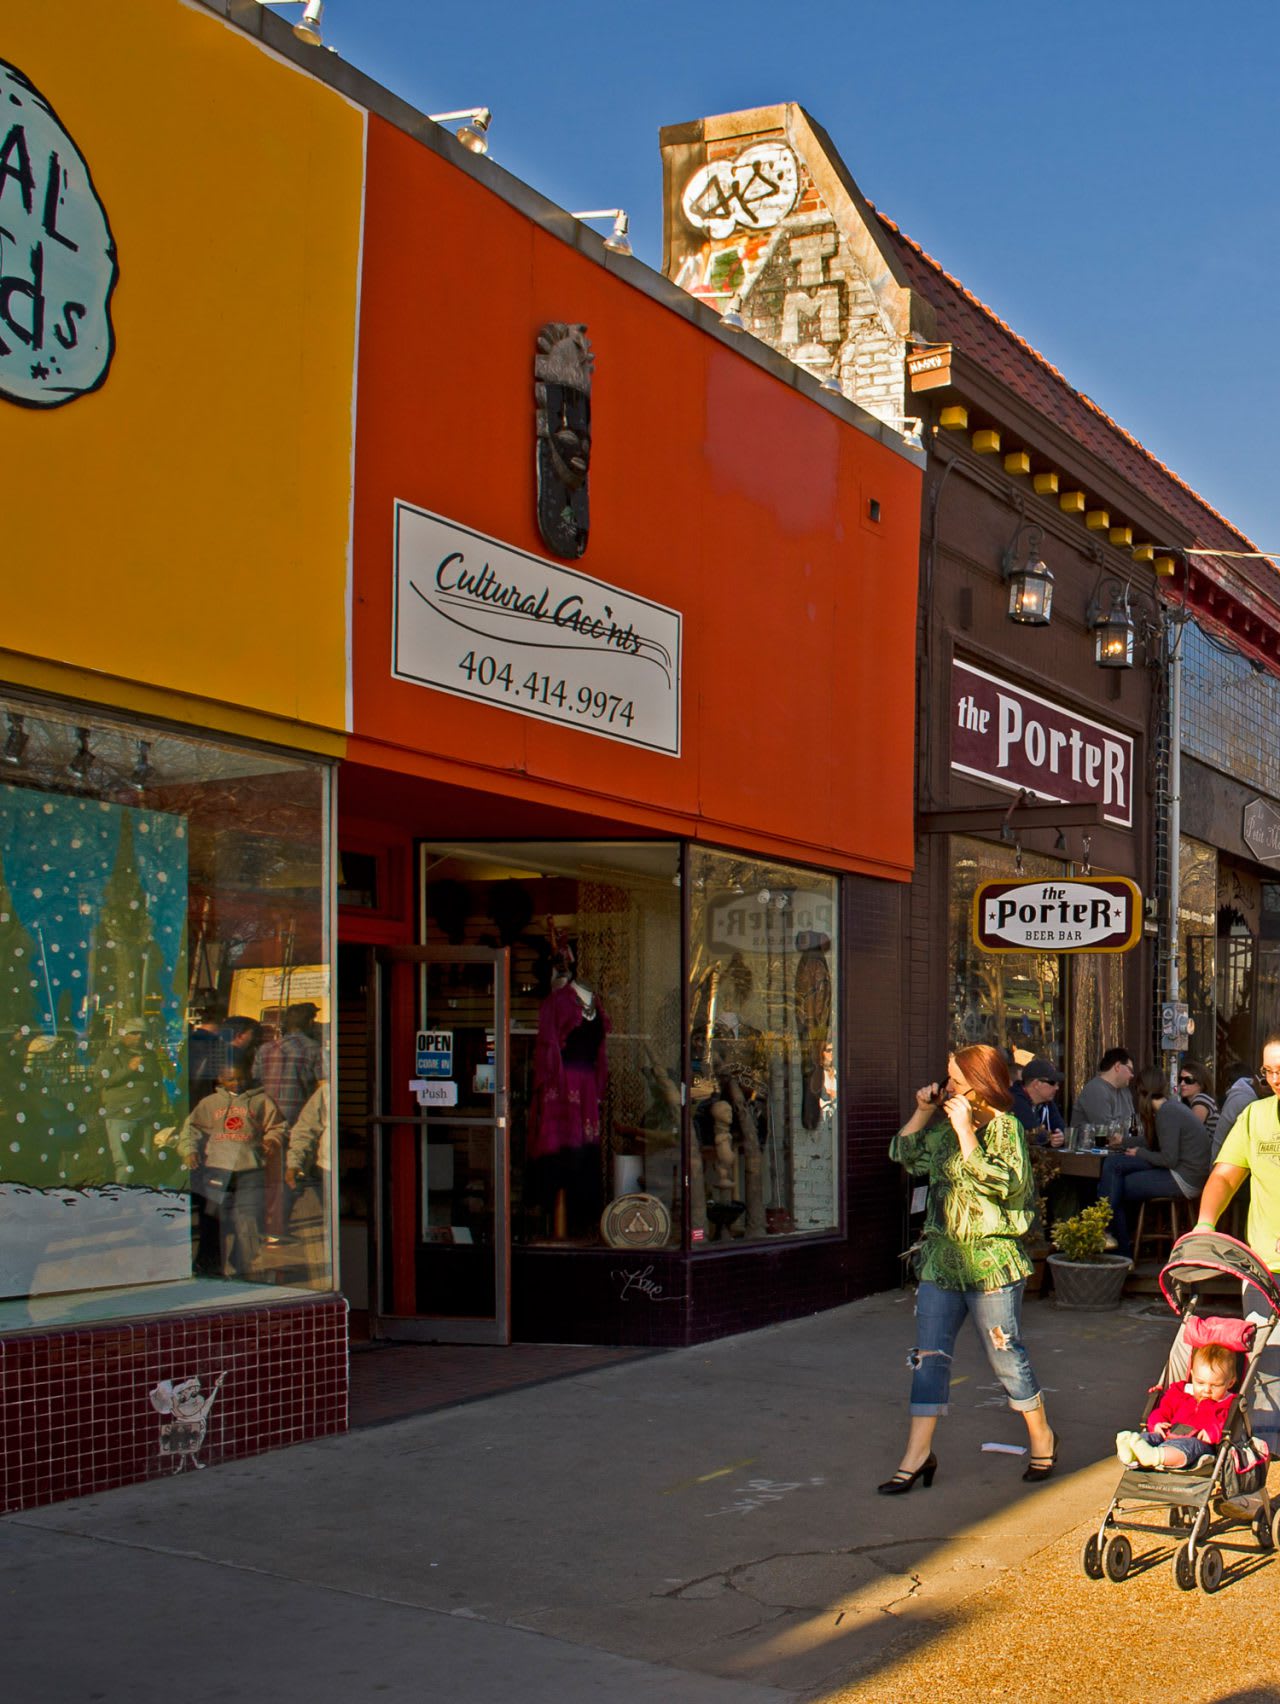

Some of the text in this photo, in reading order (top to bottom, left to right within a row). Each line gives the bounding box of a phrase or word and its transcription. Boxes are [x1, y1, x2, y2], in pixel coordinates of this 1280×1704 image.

[436, 552, 548, 620] Cultural
[458, 651, 635, 728] 404.414.9974
[957, 695, 990, 734] the
[1042, 887, 1066, 900] the
[1025, 930, 1082, 941] BEER BAR
[417, 1034, 451, 1052] OPEN
[418, 1059, 450, 1070] COME IN
[421, 1088, 448, 1100] Push
